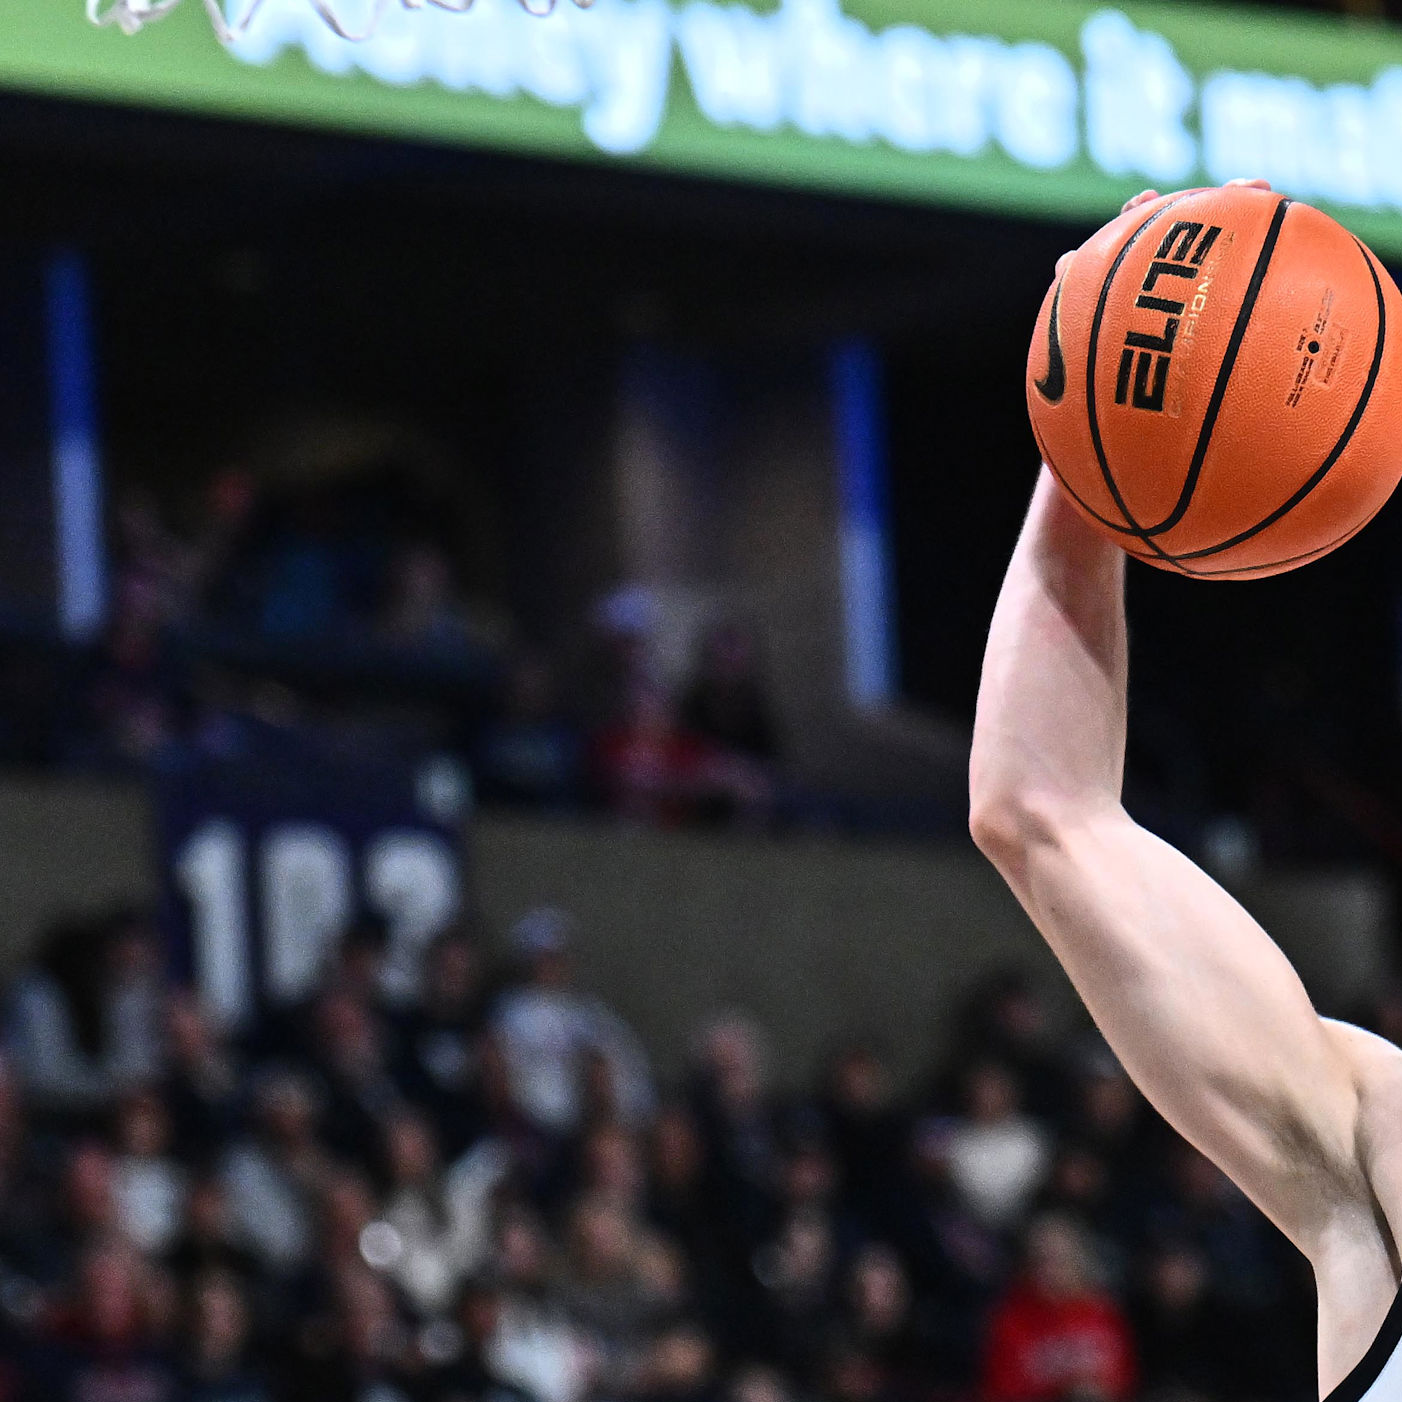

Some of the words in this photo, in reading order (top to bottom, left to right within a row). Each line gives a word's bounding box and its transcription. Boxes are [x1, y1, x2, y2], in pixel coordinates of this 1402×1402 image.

[674, 0, 1080, 172] where
[1079, 8, 1199, 186] it
[1114, 220, 1223, 413] ELITE
